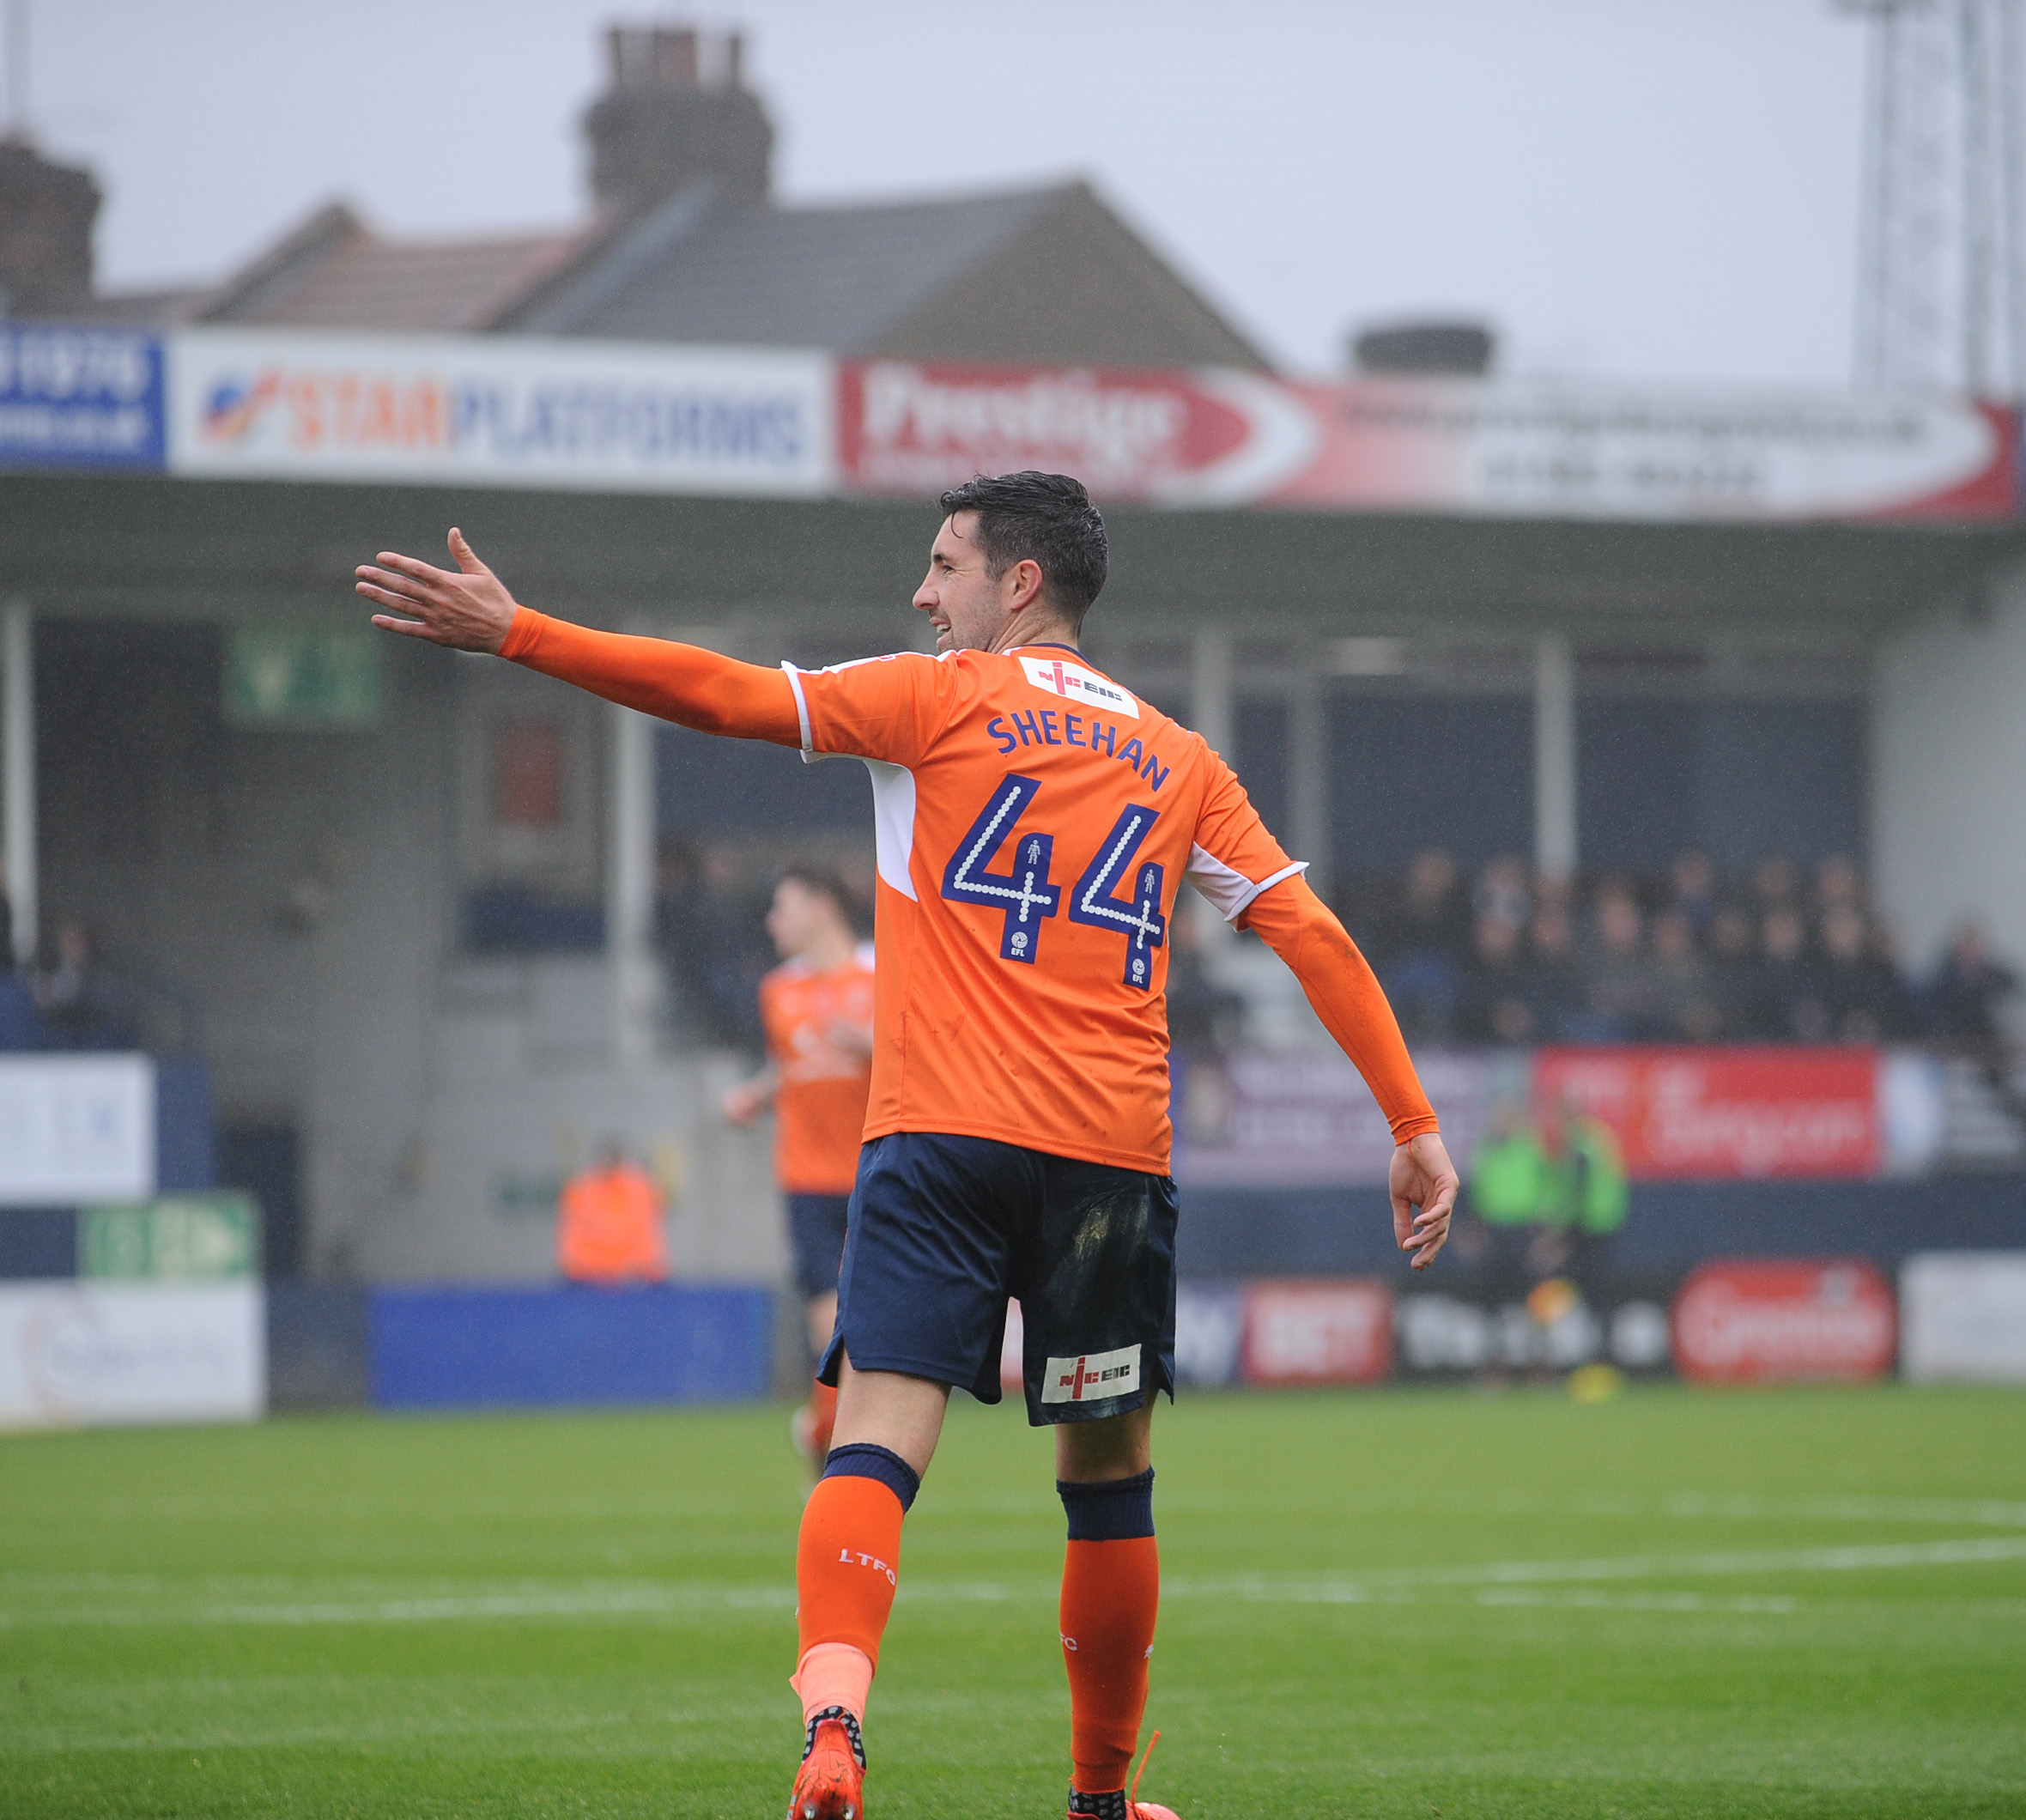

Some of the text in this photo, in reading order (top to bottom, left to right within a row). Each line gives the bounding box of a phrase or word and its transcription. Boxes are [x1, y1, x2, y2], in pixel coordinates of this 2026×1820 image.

[987, 709, 1170, 792] SHEEHAN
[941, 773, 1166, 992] 44
[1010, 947, 1025, 957] EFL
[1131, 974, 1143, 985] EFL
